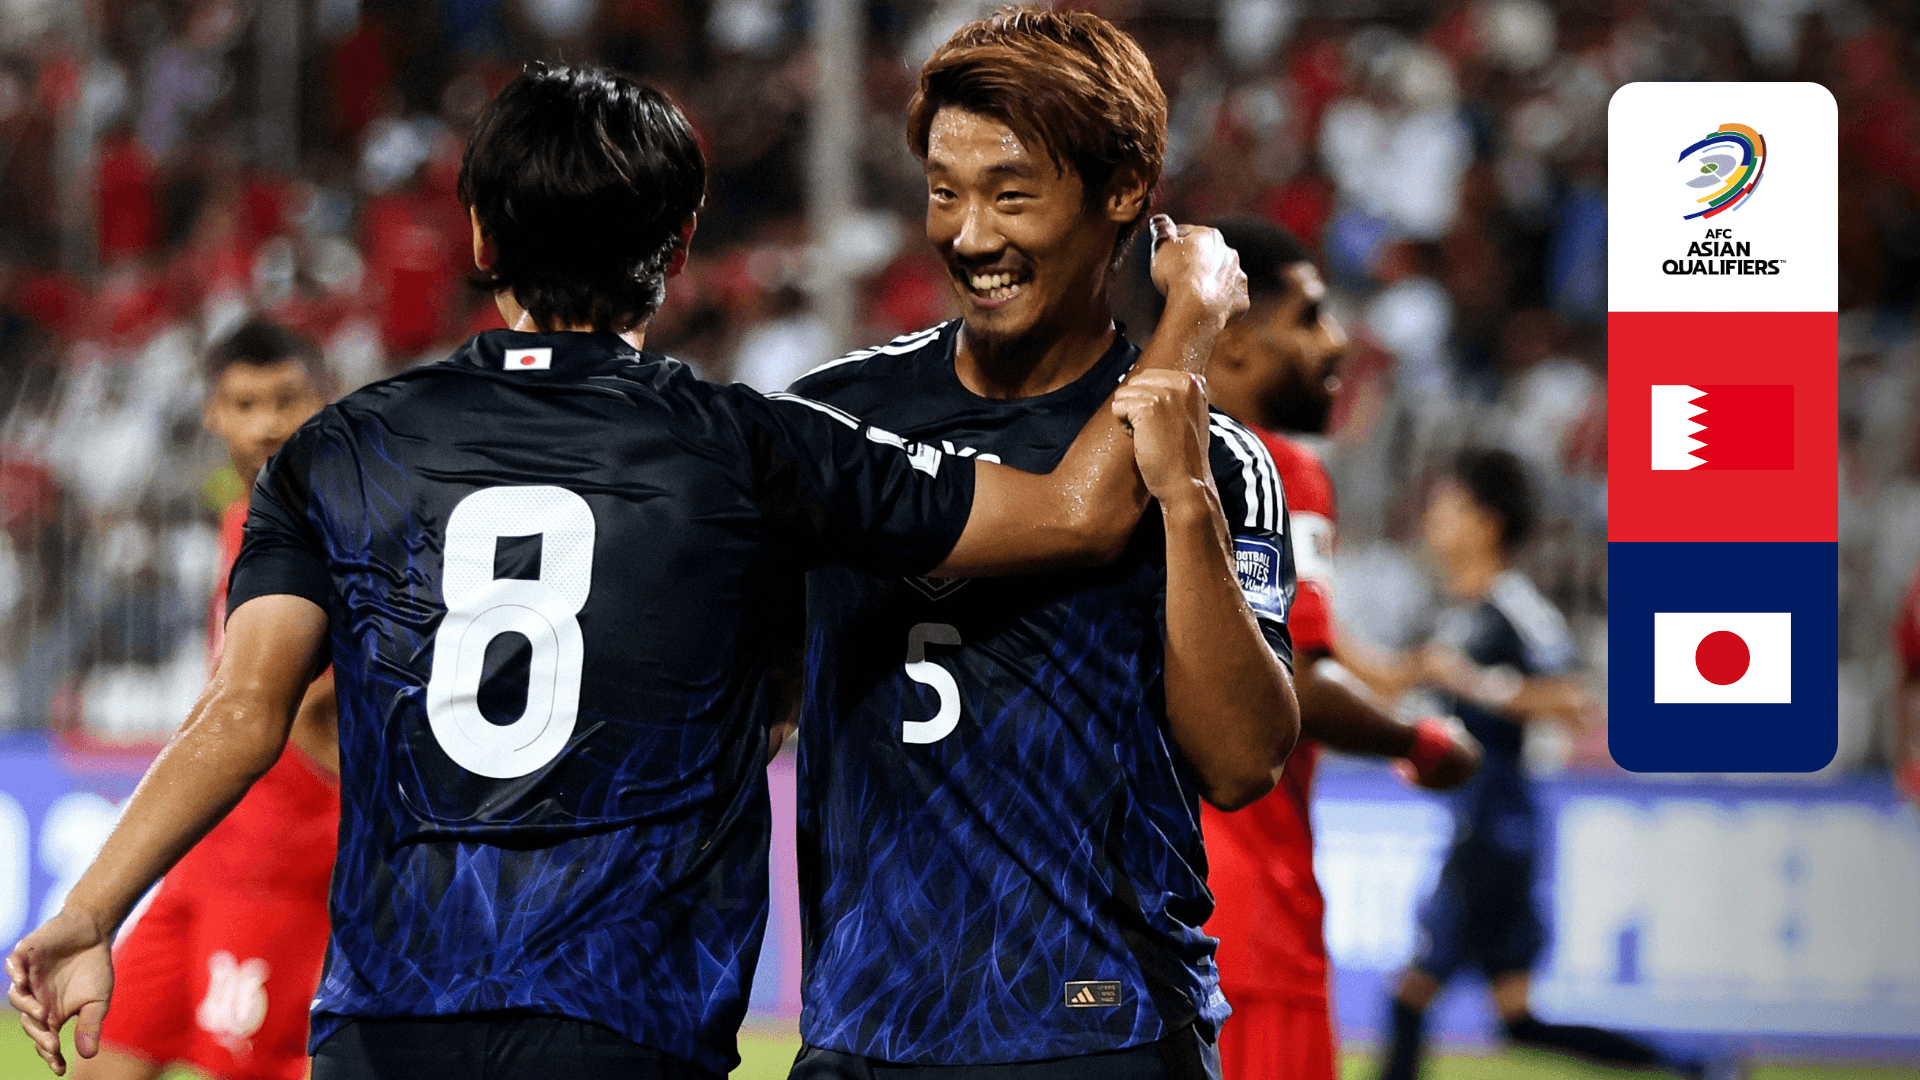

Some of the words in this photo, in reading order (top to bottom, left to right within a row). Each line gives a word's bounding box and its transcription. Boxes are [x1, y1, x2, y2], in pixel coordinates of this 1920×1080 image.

[1233, 550, 1270, 568] OOTBALL
[426, 485, 596, 779] 8
[902, 622, 962, 745] 5
